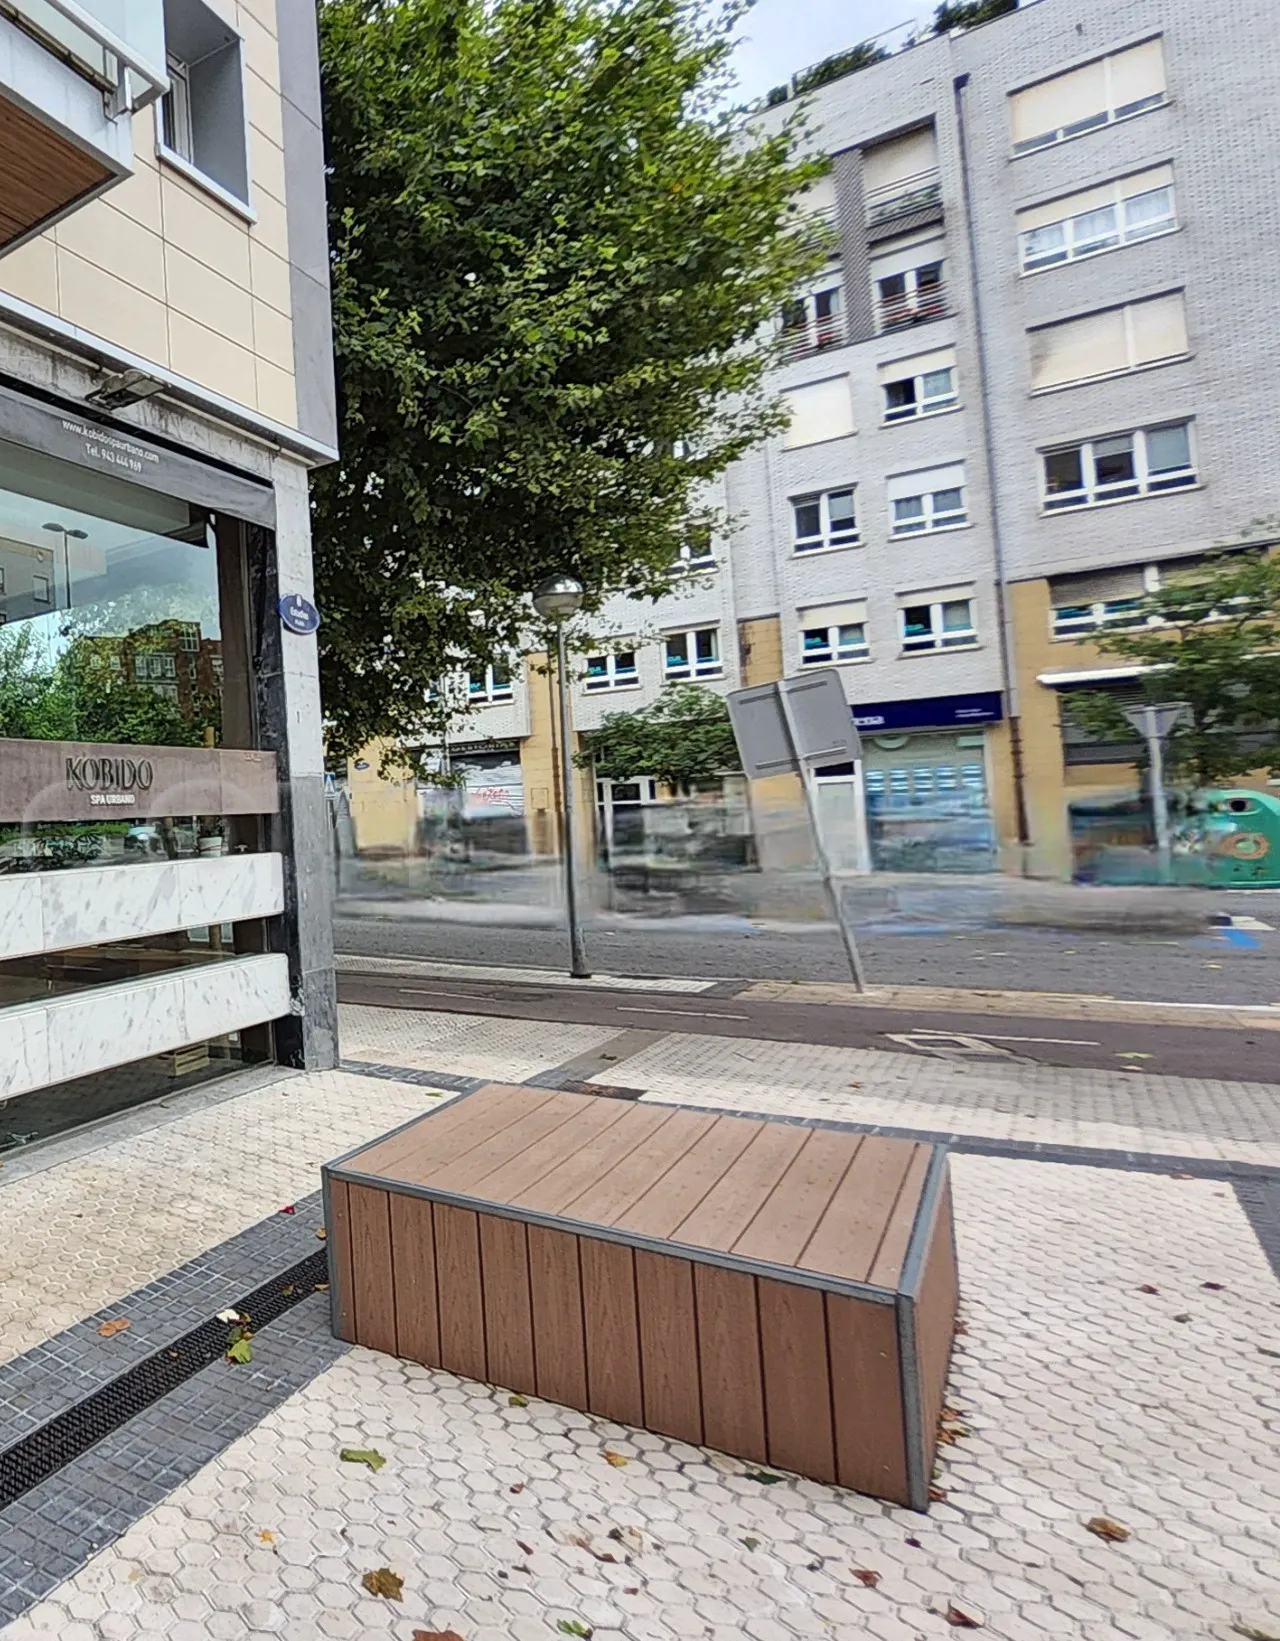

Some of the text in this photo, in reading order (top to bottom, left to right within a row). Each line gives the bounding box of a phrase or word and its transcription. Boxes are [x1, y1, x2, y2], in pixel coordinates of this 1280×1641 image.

[101, 448, 115, 463] 943
[65, 757, 154, 791] KOBIDO
[90, 794, 136, 805] SPA URBANO
